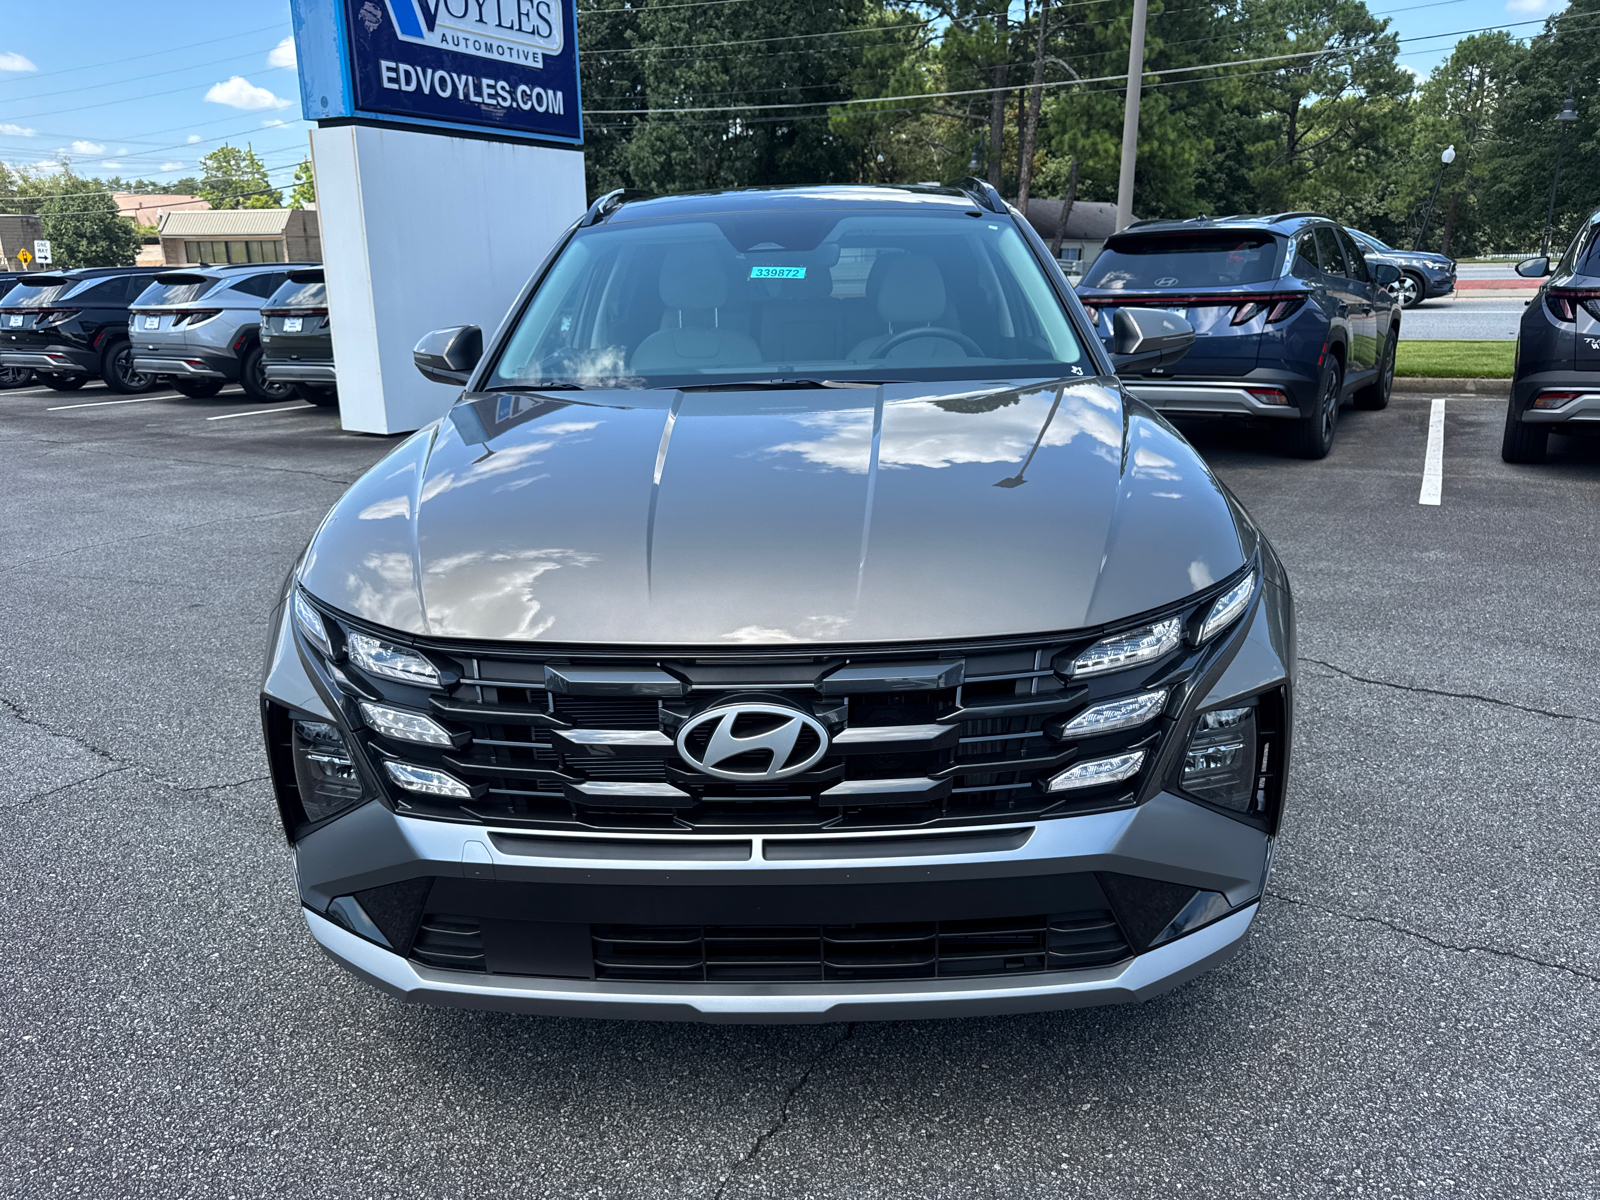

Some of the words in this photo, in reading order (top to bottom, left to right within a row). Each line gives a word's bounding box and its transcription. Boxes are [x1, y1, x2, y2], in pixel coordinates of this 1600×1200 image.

[440, 33, 540, 64] AUTOMOTIVE
[381, 60, 565, 115] EDVOYLES.COM
[755, 268, 800, 278] 339872
